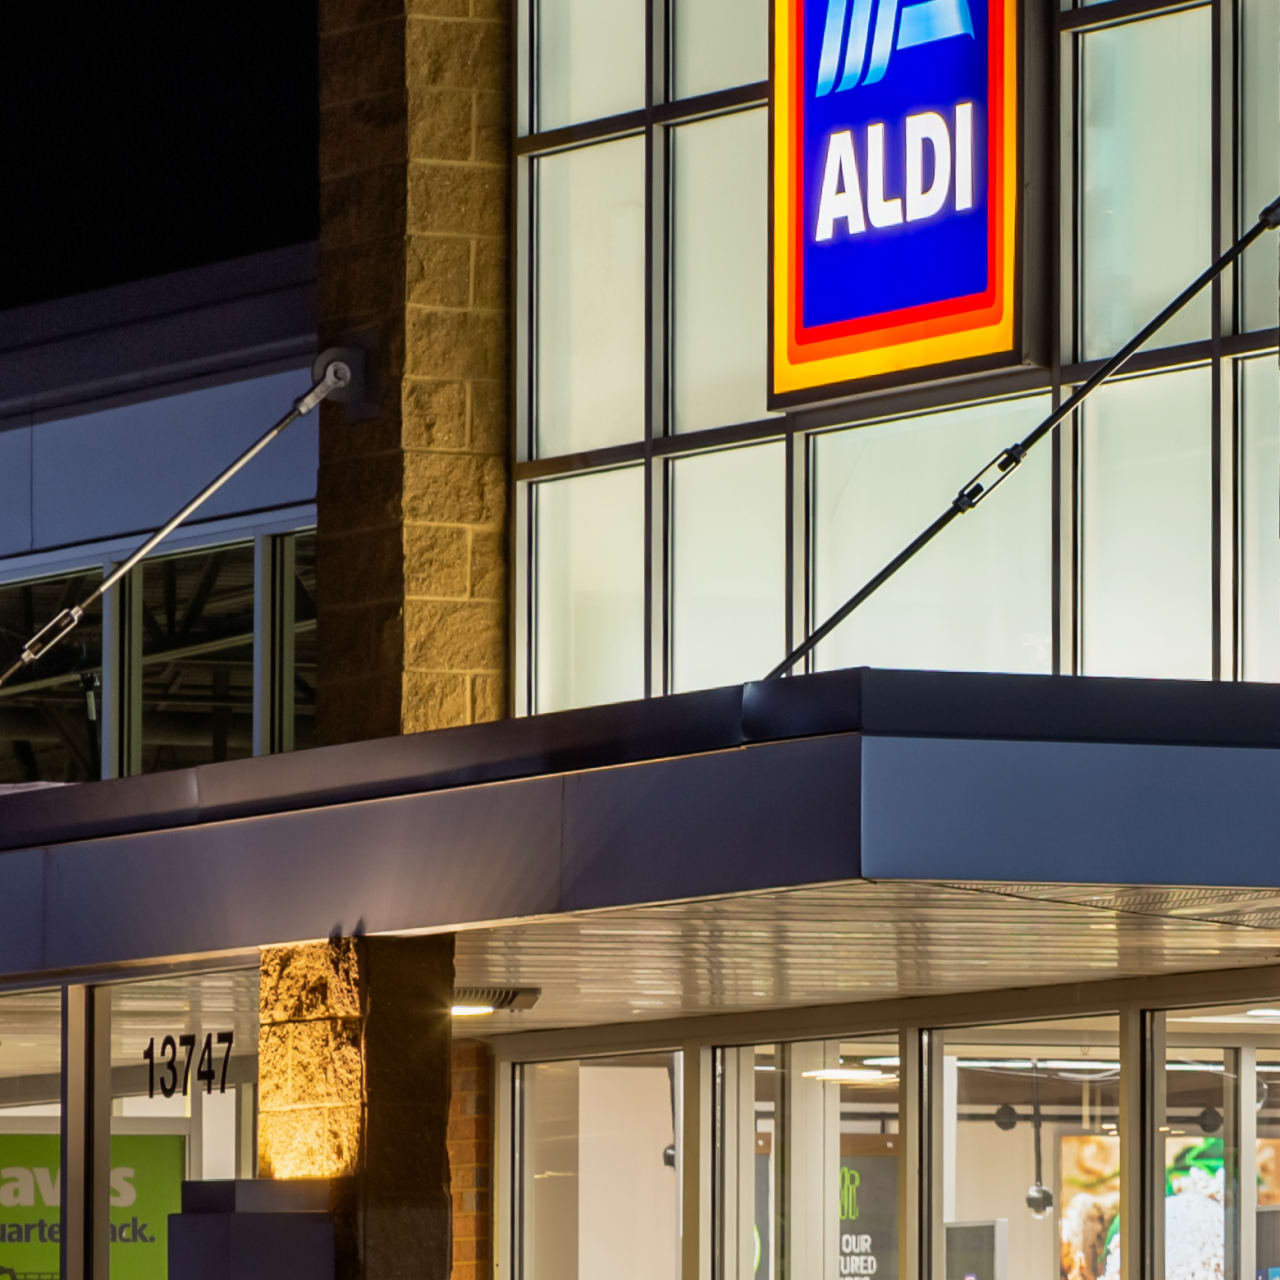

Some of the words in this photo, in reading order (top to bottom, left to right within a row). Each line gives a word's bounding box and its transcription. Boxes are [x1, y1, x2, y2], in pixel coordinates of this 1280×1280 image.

[815, 102, 973, 243] ALDI
[143, 1031, 234, 1099] 13747
[841, 1234, 872, 1253] OUR
